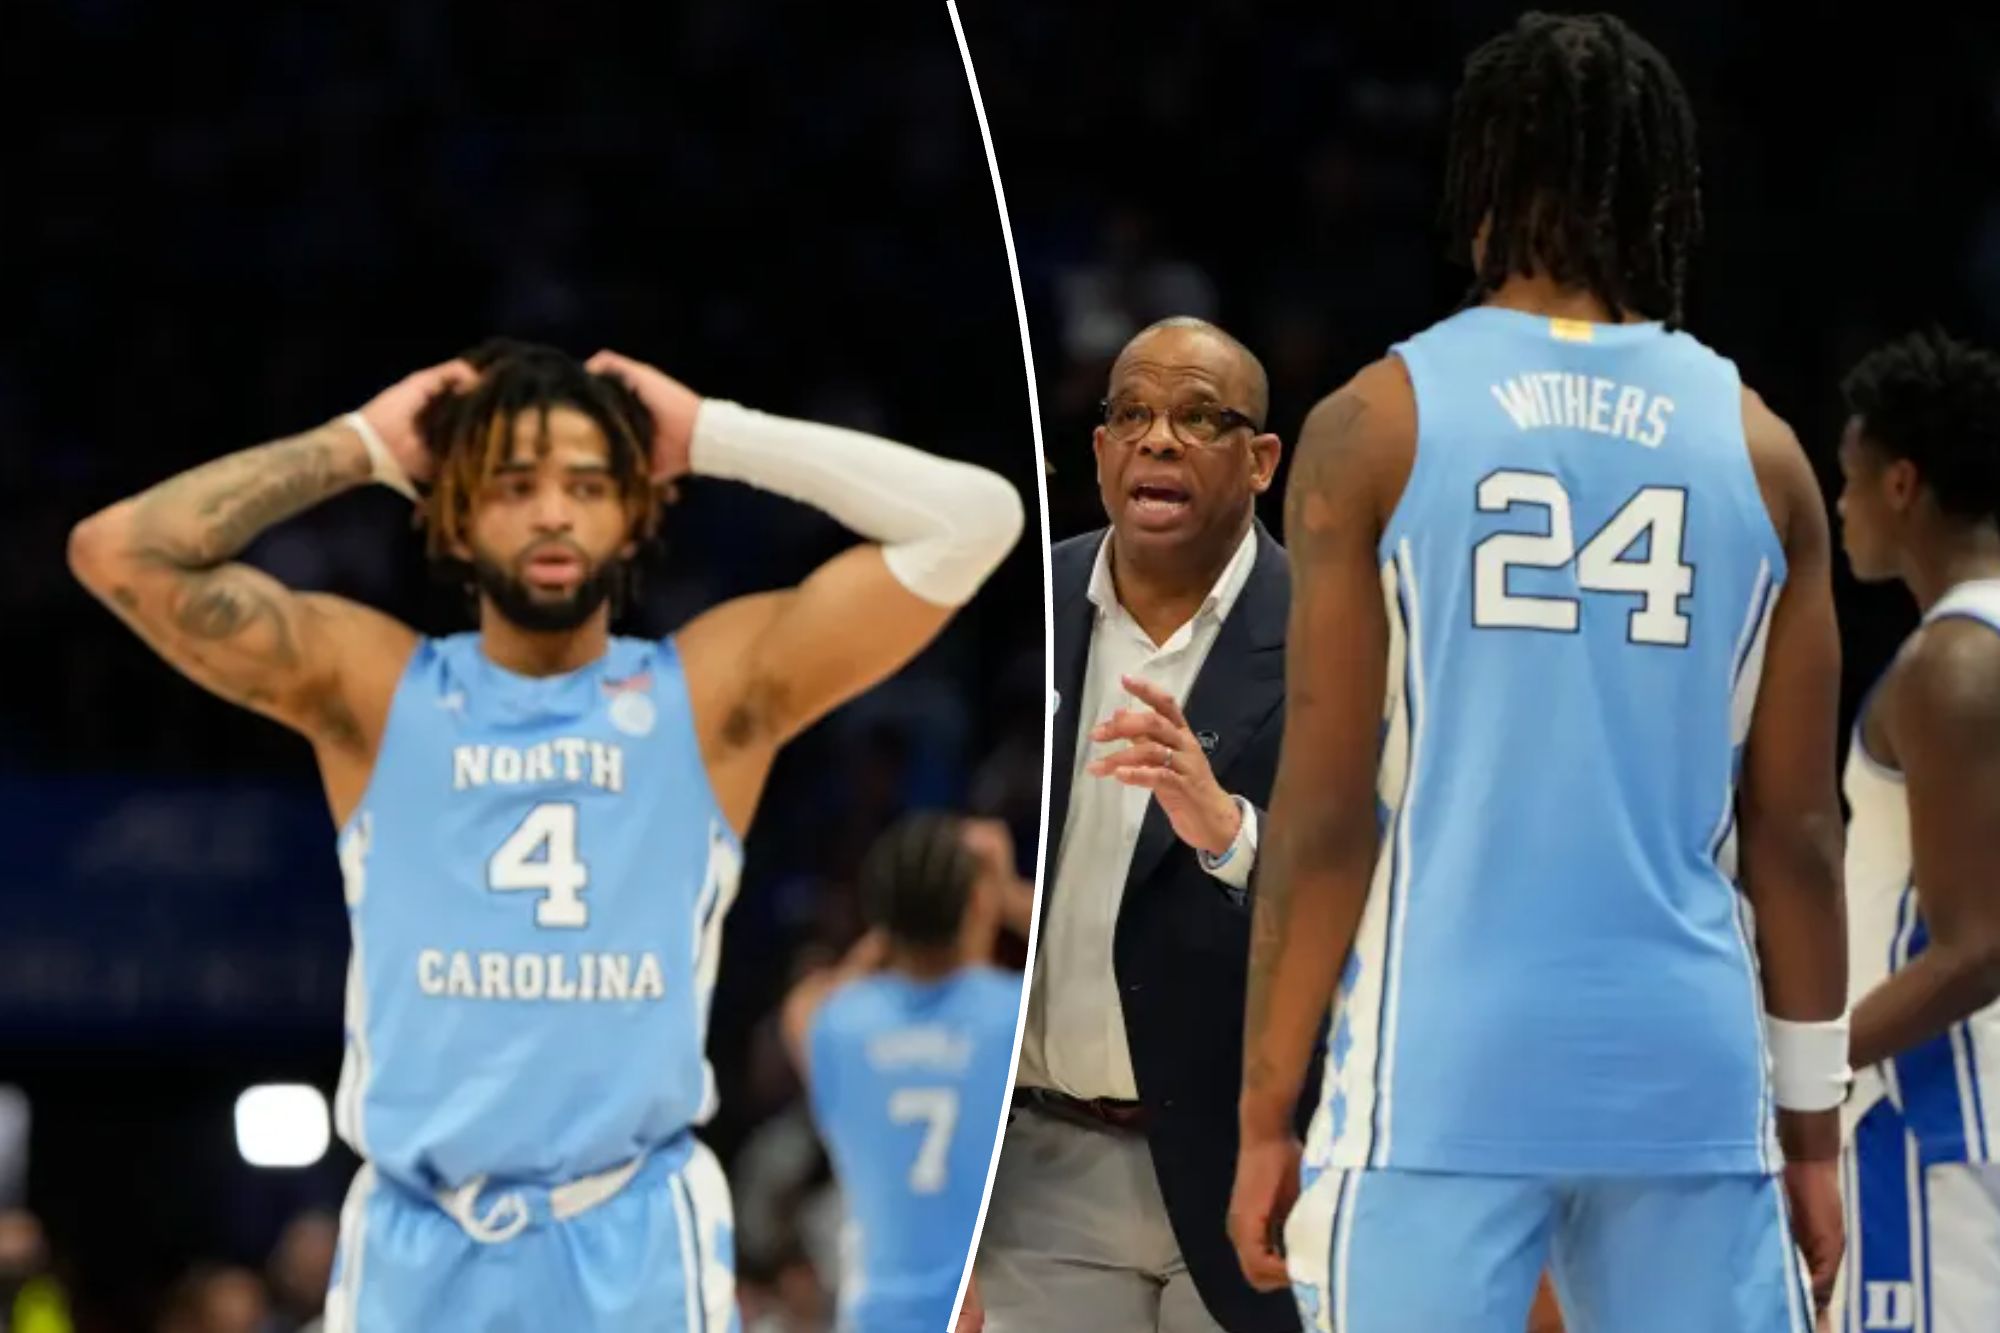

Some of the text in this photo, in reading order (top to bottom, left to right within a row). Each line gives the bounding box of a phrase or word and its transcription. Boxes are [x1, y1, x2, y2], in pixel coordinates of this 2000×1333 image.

[1490, 370, 1675, 449] WITHERS
[1471, 467, 1696, 648] 24
[452, 737, 624, 794] NORTH
[487, 799, 590, 929] 4
[417, 948, 665, 1001] CAROLINA
[887, 1086, 960, 1195] 7
